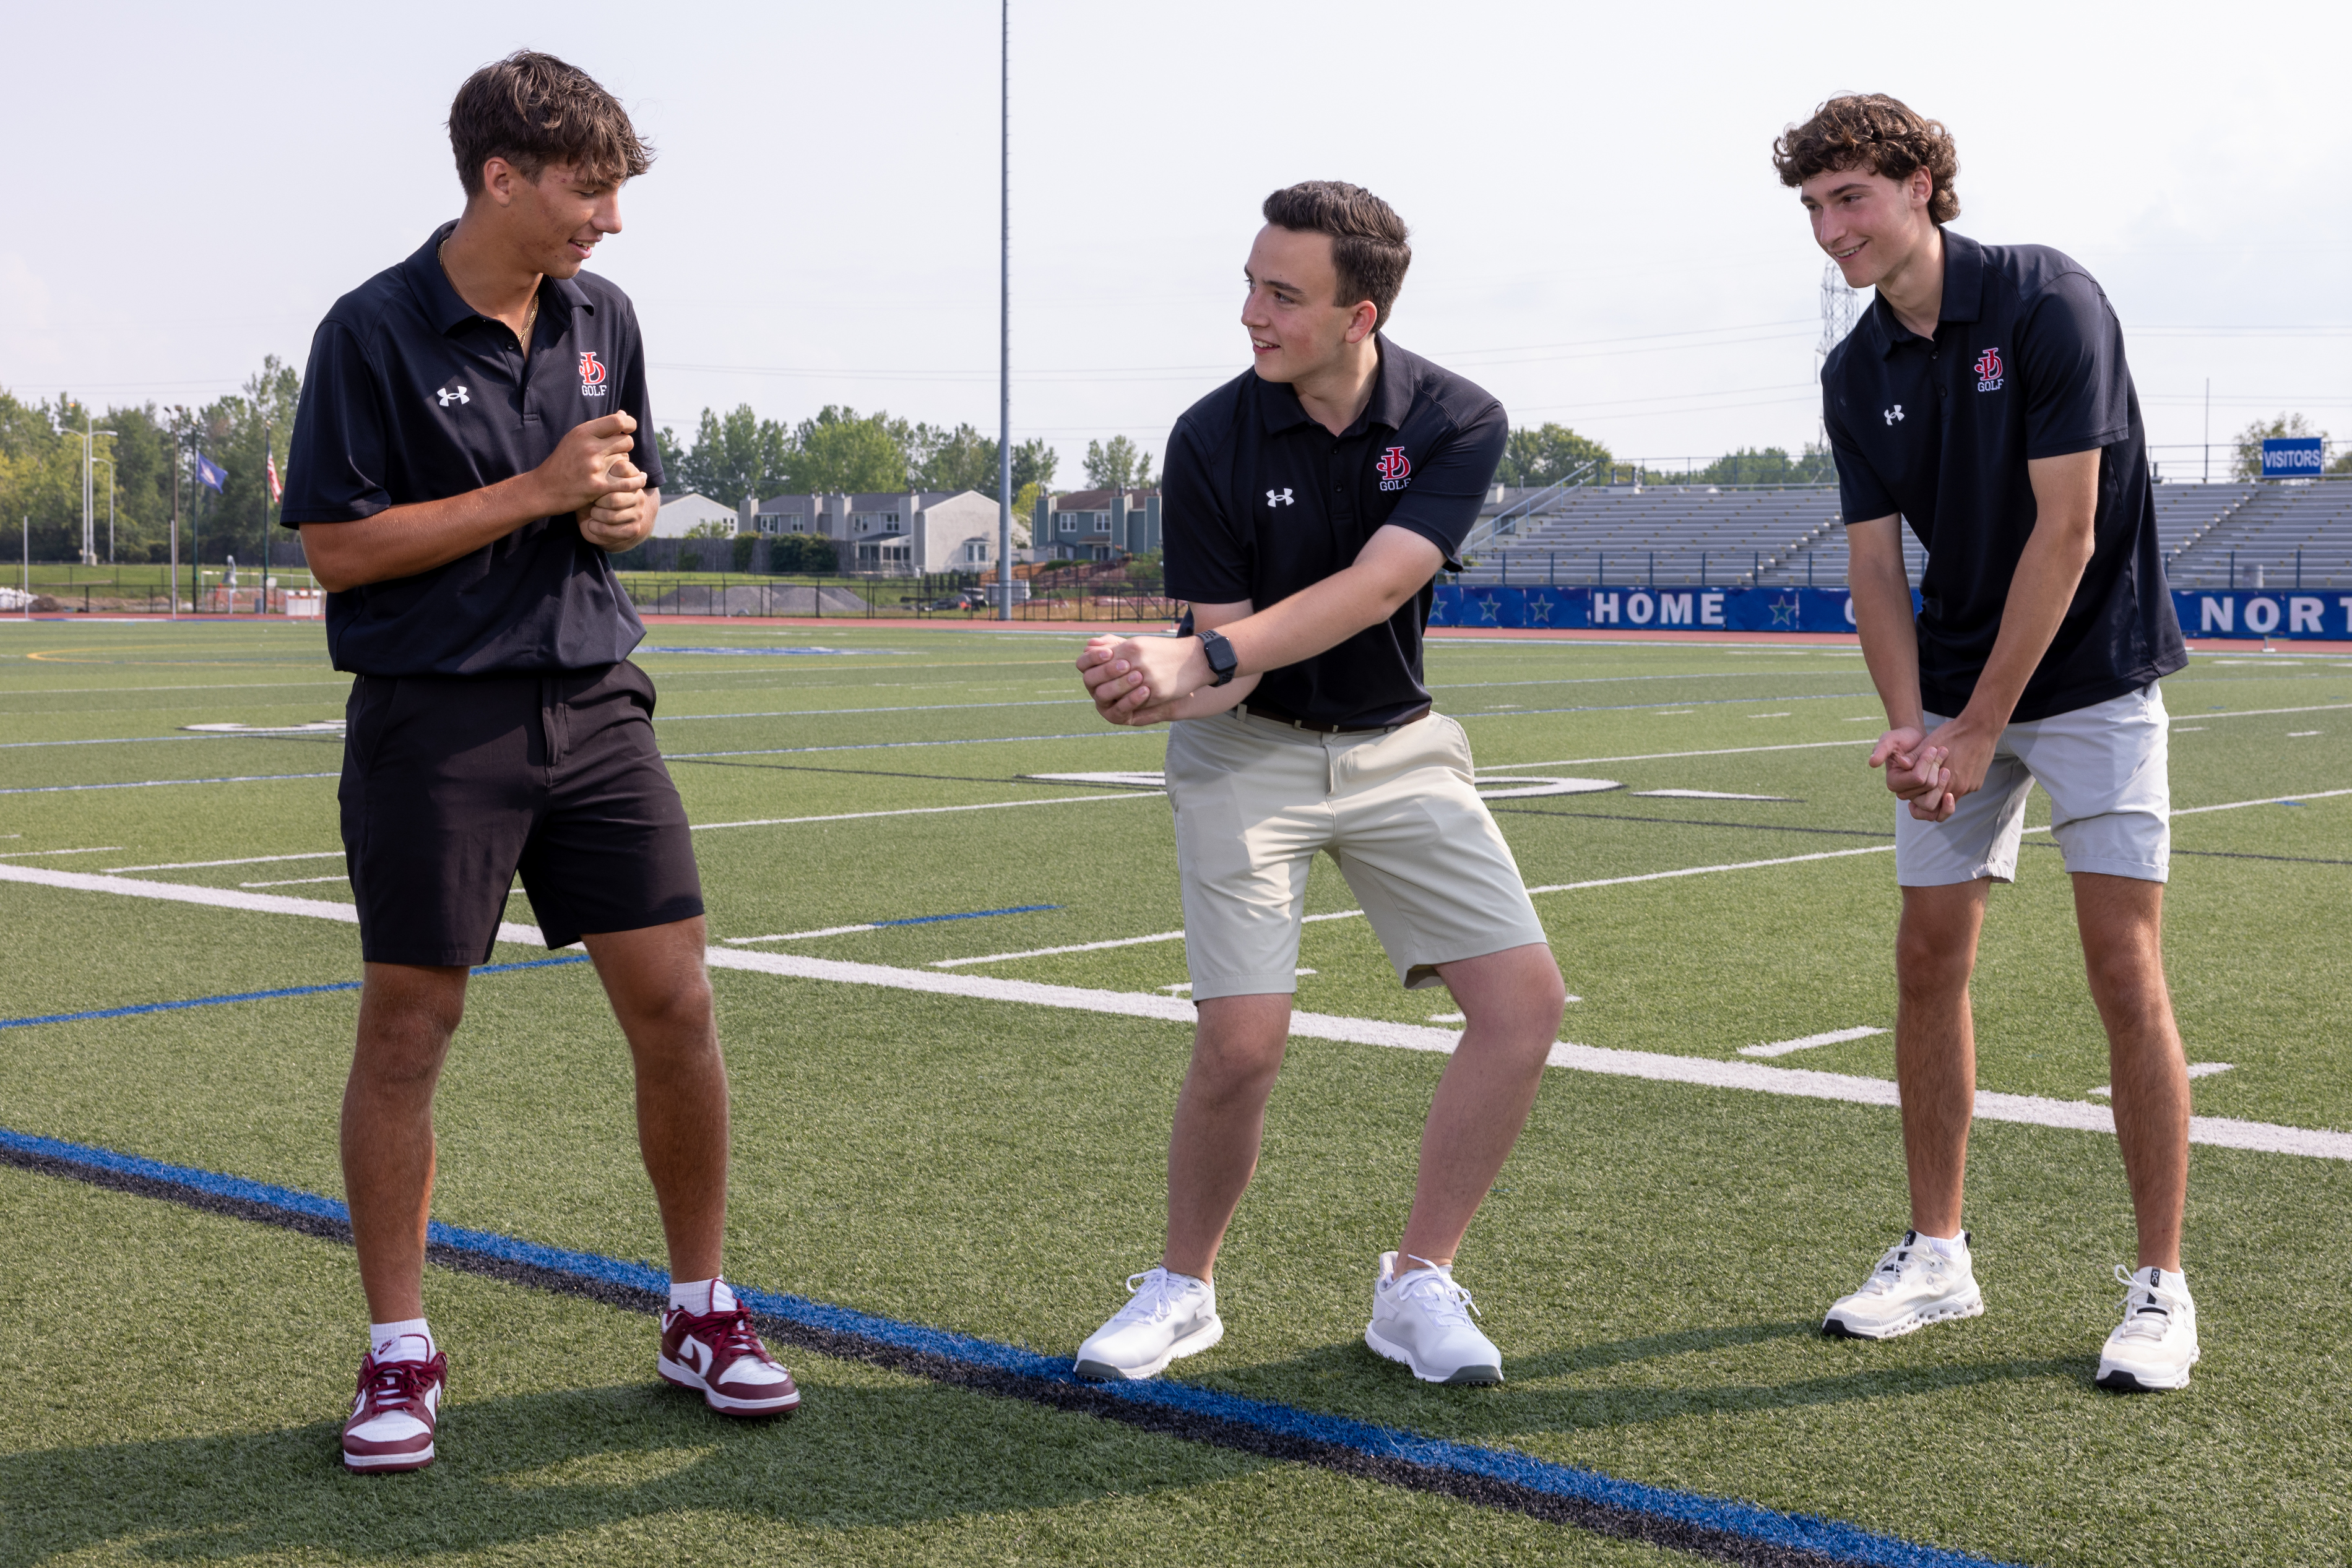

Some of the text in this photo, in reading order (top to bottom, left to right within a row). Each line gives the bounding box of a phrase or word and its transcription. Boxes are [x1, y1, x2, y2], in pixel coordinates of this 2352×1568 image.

[582, 385, 607, 396] GOLF
[1977, 379, 2004, 392] GOLF
[2263, 449, 2320, 468] VISITORS
[1379, 478, 1412, 491] GOLF
[1594, 593, 1724, 624] HOME
